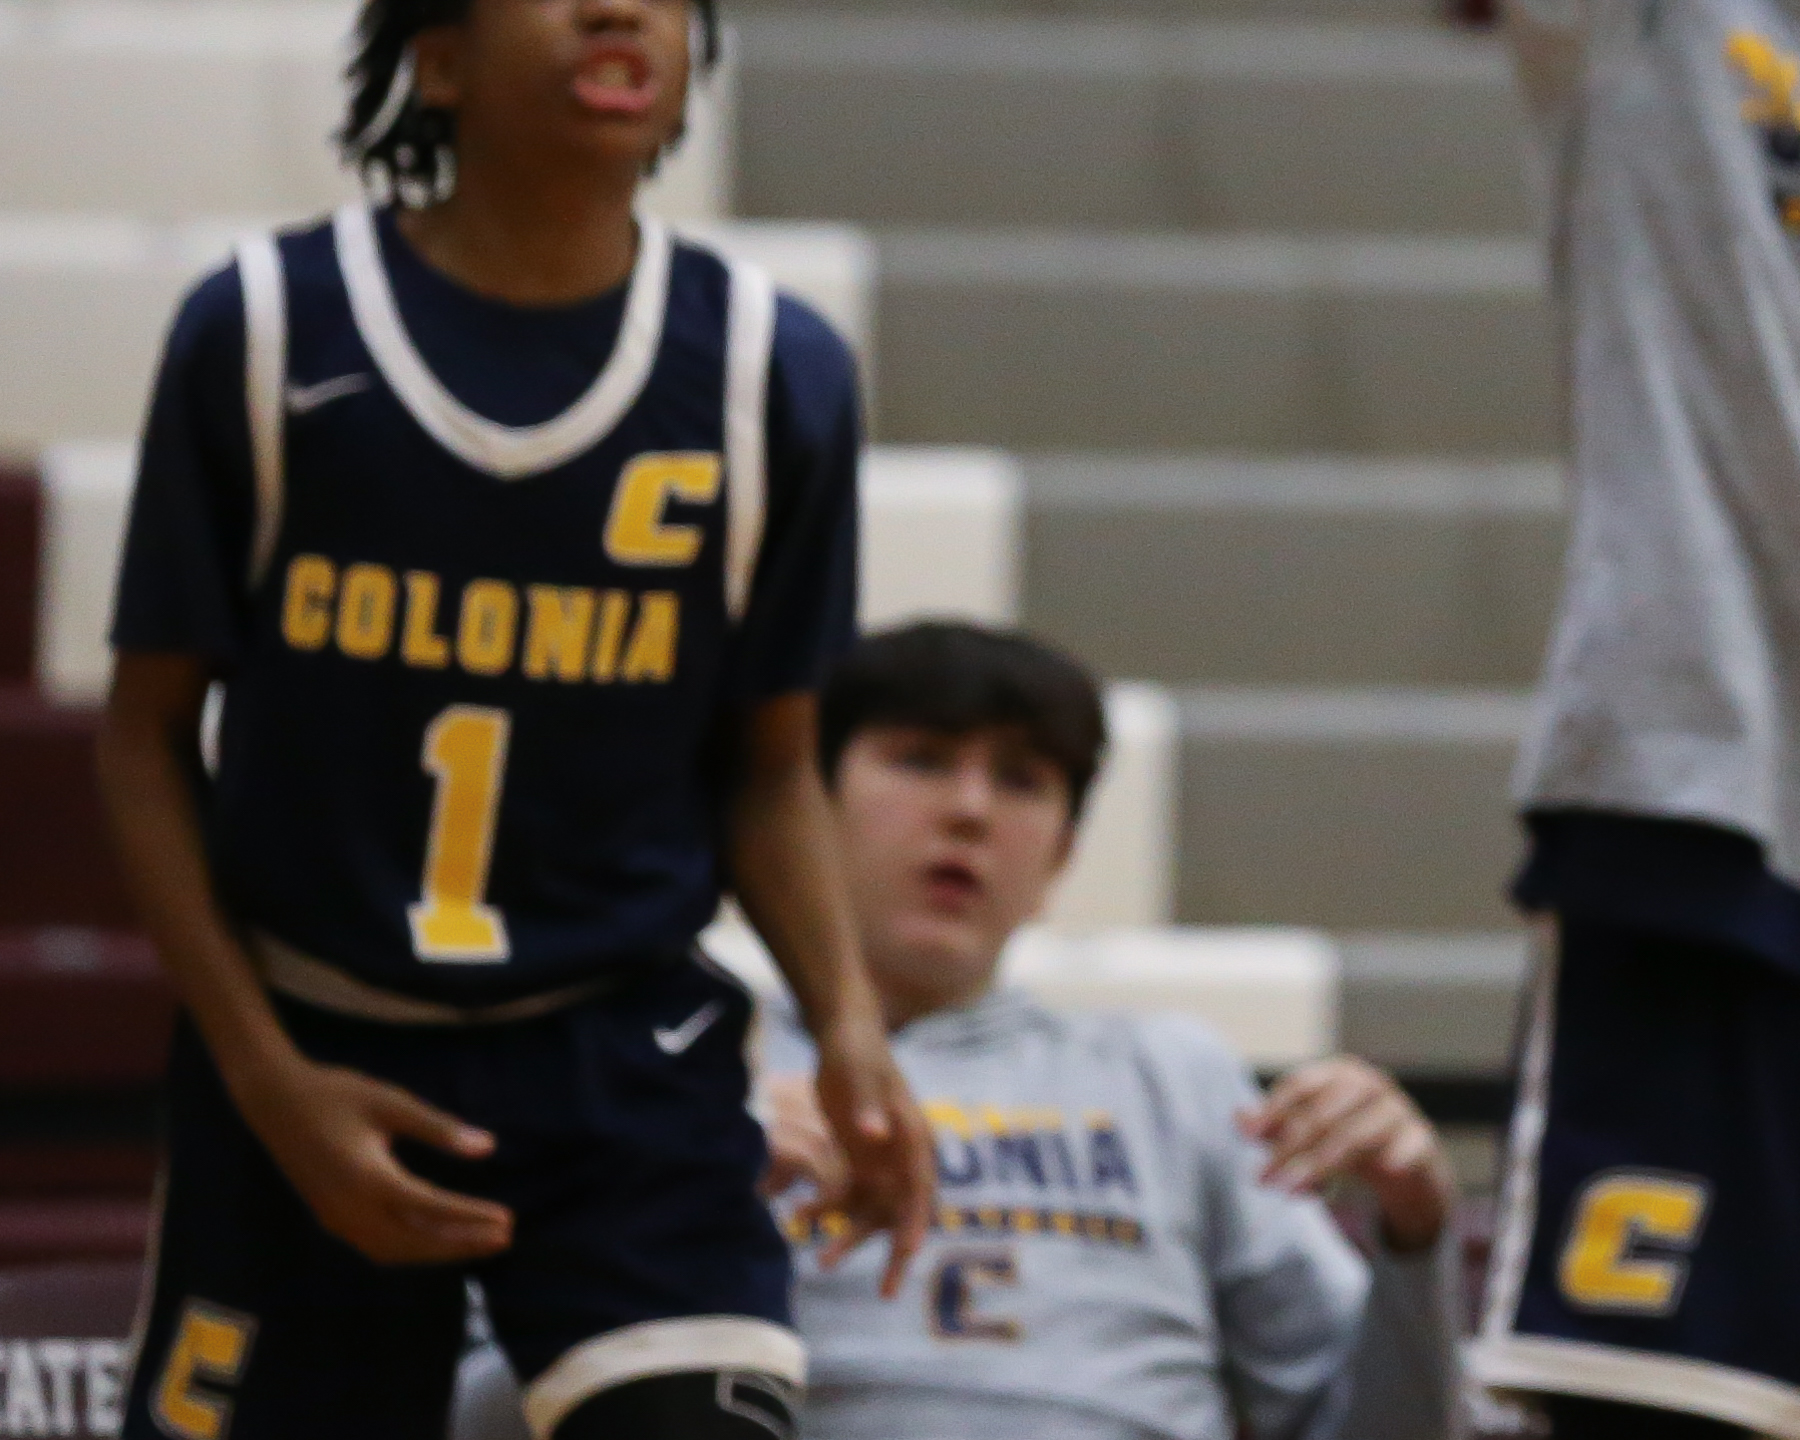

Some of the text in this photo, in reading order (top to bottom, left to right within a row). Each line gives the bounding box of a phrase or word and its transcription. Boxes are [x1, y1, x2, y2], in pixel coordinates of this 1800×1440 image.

[603, 449, 722, 567] C
[281, 553, 680, 683] COLONIA
[408, 703, 511, 963] 1
[927, 1245, 1026, 1342] C
[1557, 1167, 1712, 1318] C
[0, 1337, 134, 1438] ATE
[150, 1295, 260, 1440] C
